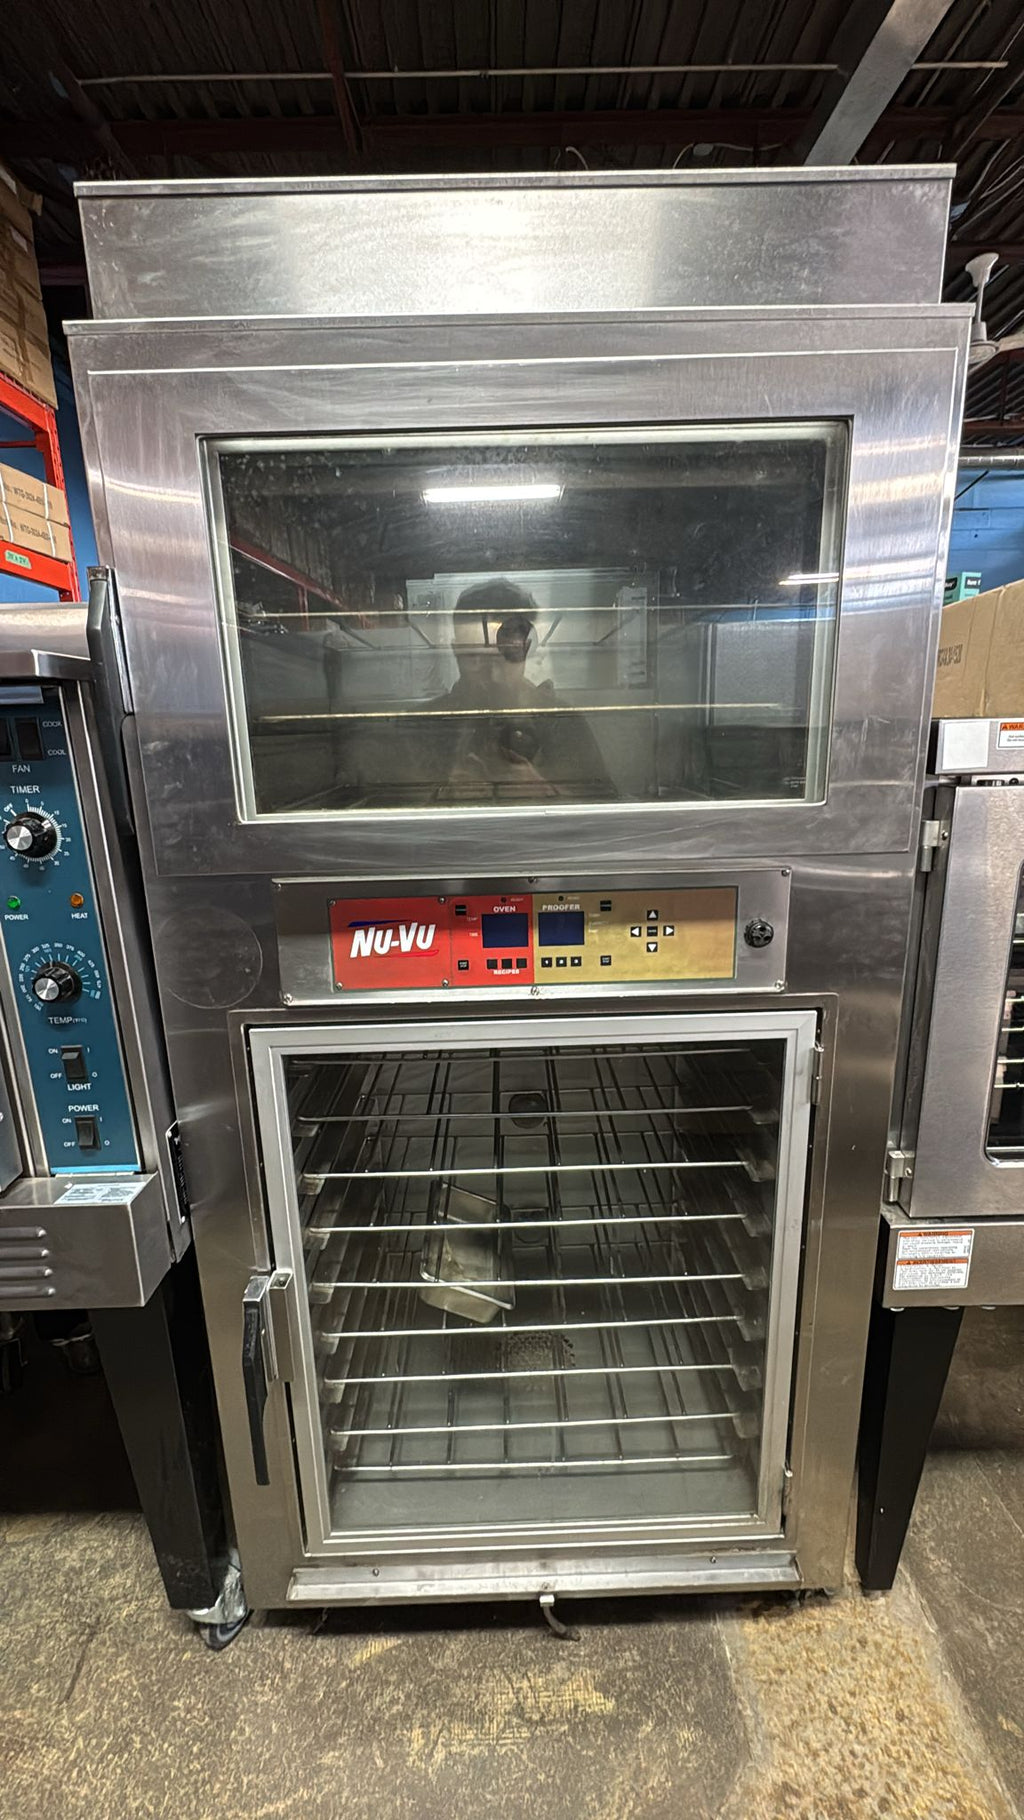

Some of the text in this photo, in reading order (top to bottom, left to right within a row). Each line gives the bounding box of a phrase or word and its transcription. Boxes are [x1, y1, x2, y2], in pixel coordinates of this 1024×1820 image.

[12, 765, 31, 773] FAN
[10, 785, 41, 794] TIMER
[67, 1083, 92, 1091] LIGHT
[68, 1104, 99, 1112] POWER
